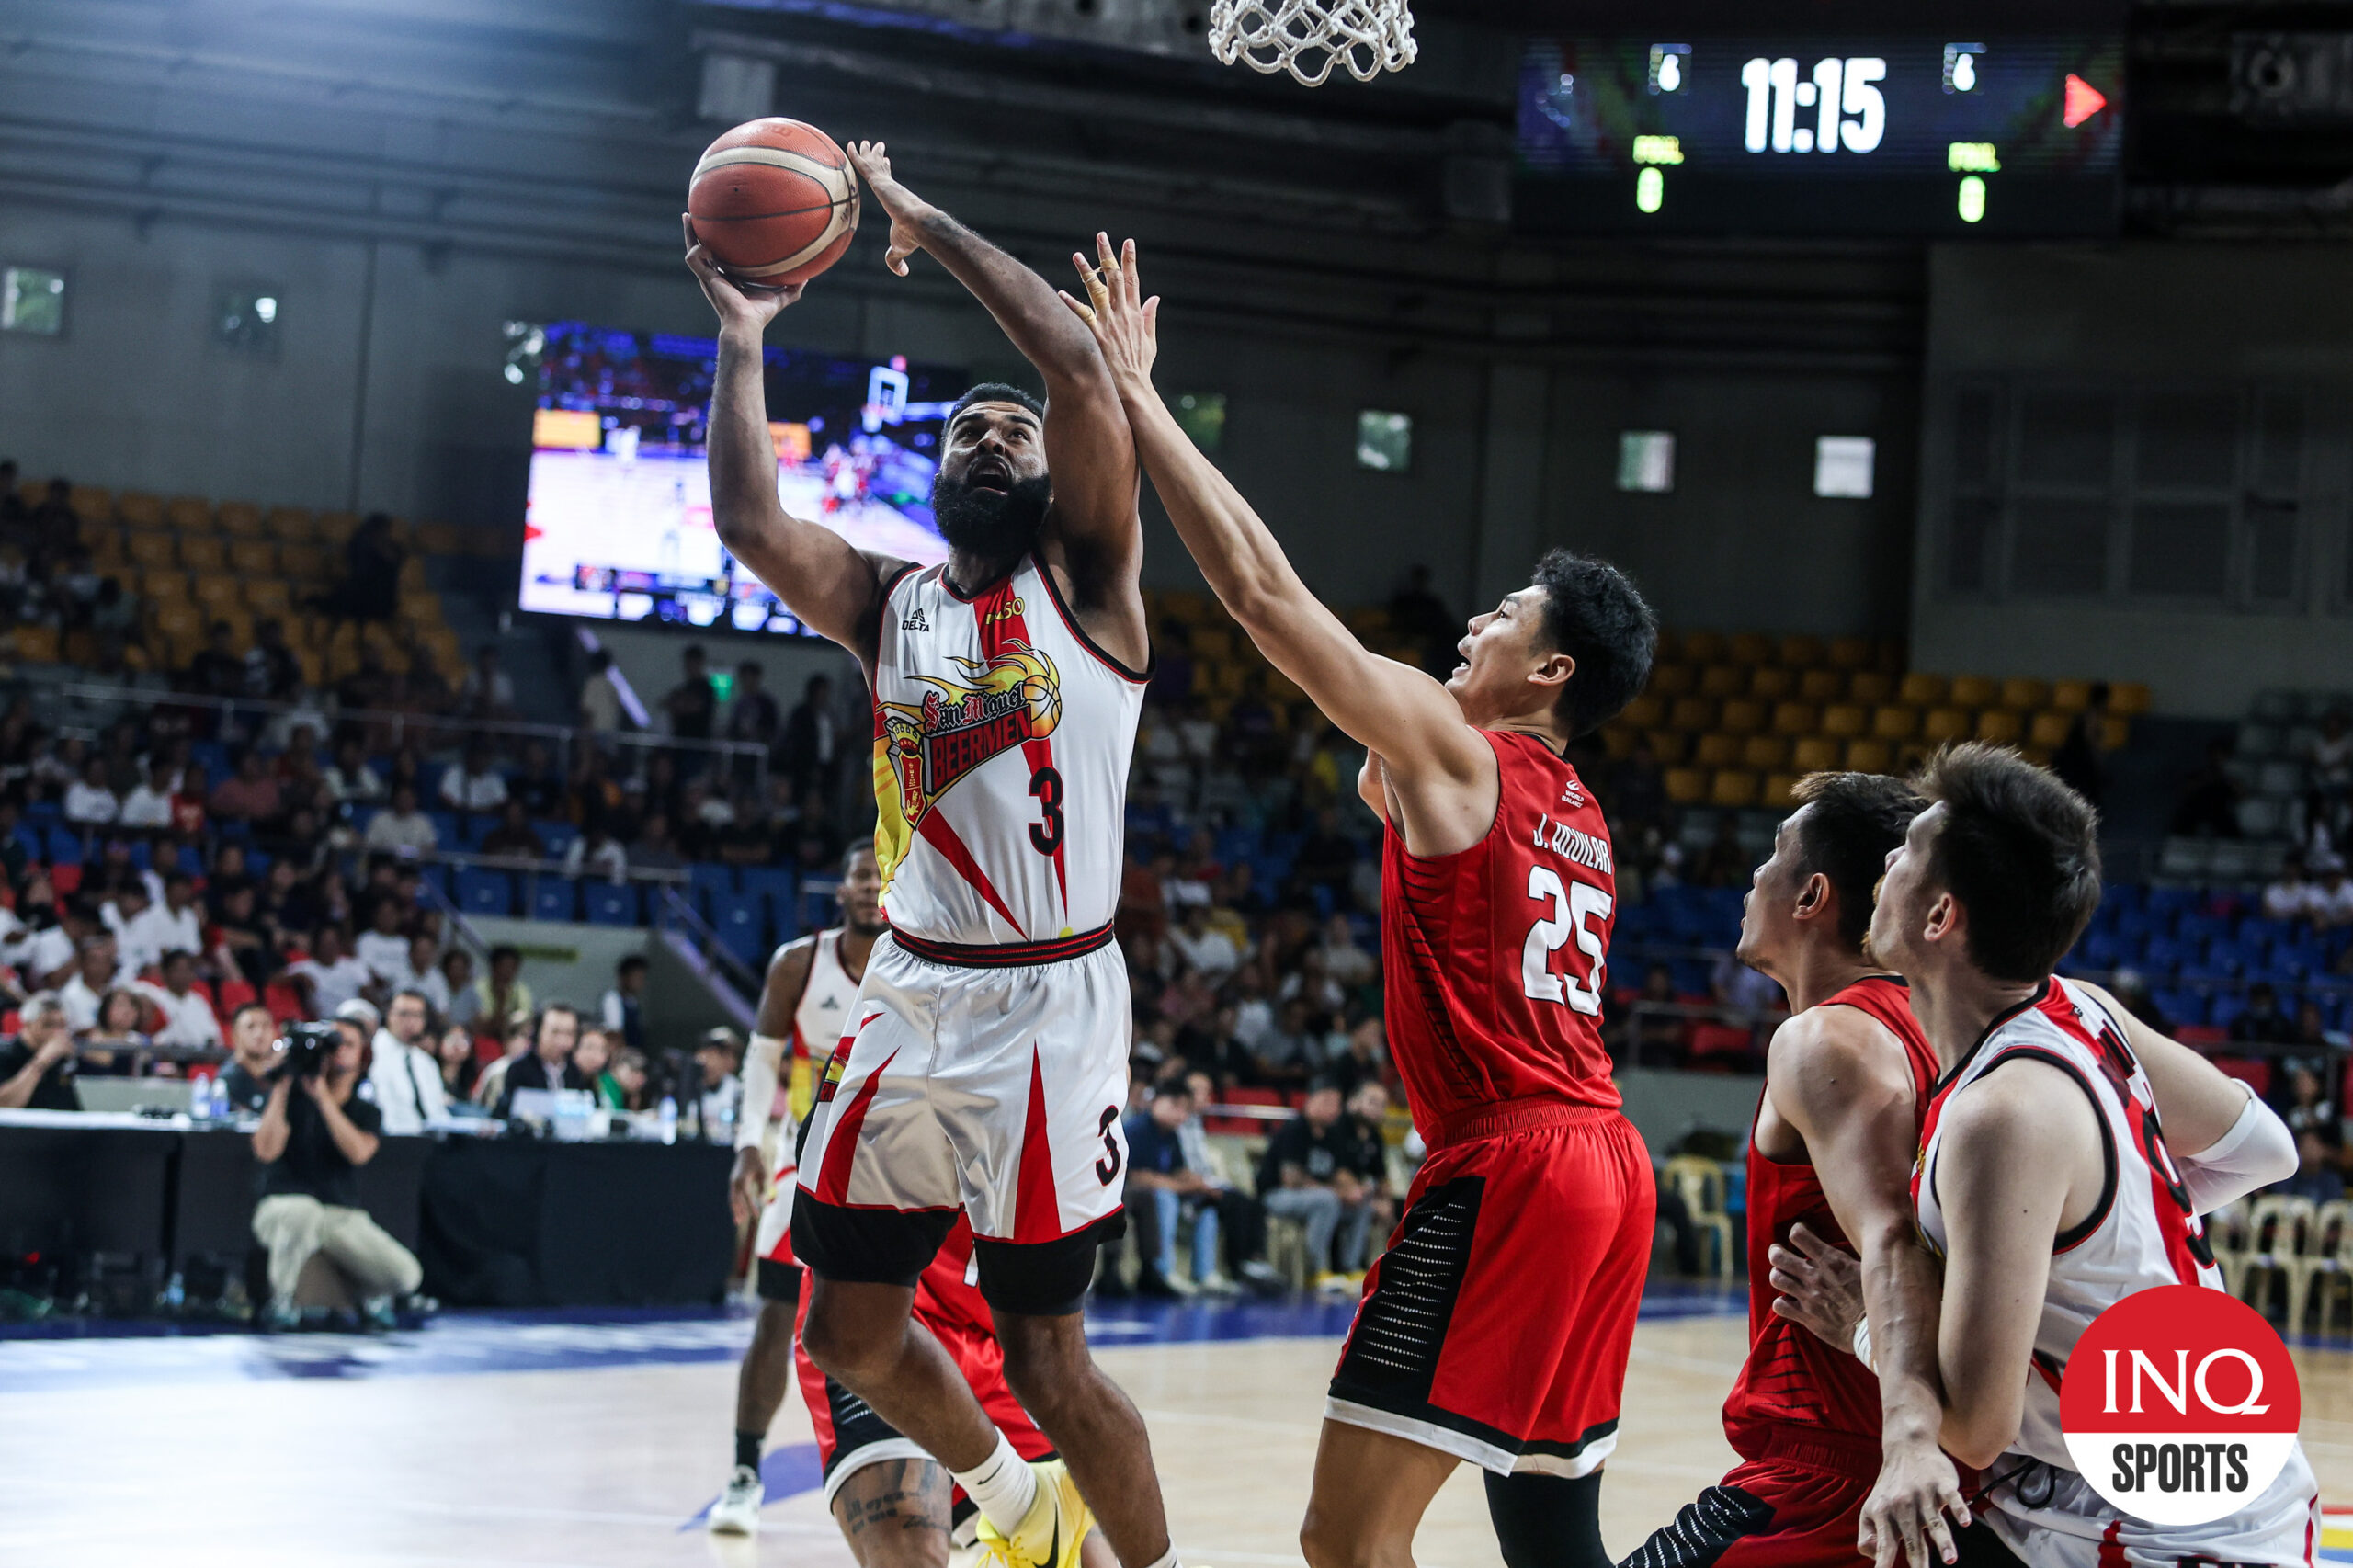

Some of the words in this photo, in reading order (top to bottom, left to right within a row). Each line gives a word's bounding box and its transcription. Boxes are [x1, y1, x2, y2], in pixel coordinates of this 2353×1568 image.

[1742, 57, 1886, 153] 11:15
[901, 619, 930, 632] DELTA
[923, 691, 961, 732] San
[962, 681, 1028, 726] Miguel
[933, 706, 1031, 790] BEERMEN
[1028, 767, 1065, 857] 3
[1565, 790, 1585, 802] WORLD
[1533, 812, 1550, 850] J.
[1552, 820, 1612, 875] AGUILAR
[1522, 864, 1613, 1017] 25
[1095, 1104, 1120, 1187] 3
